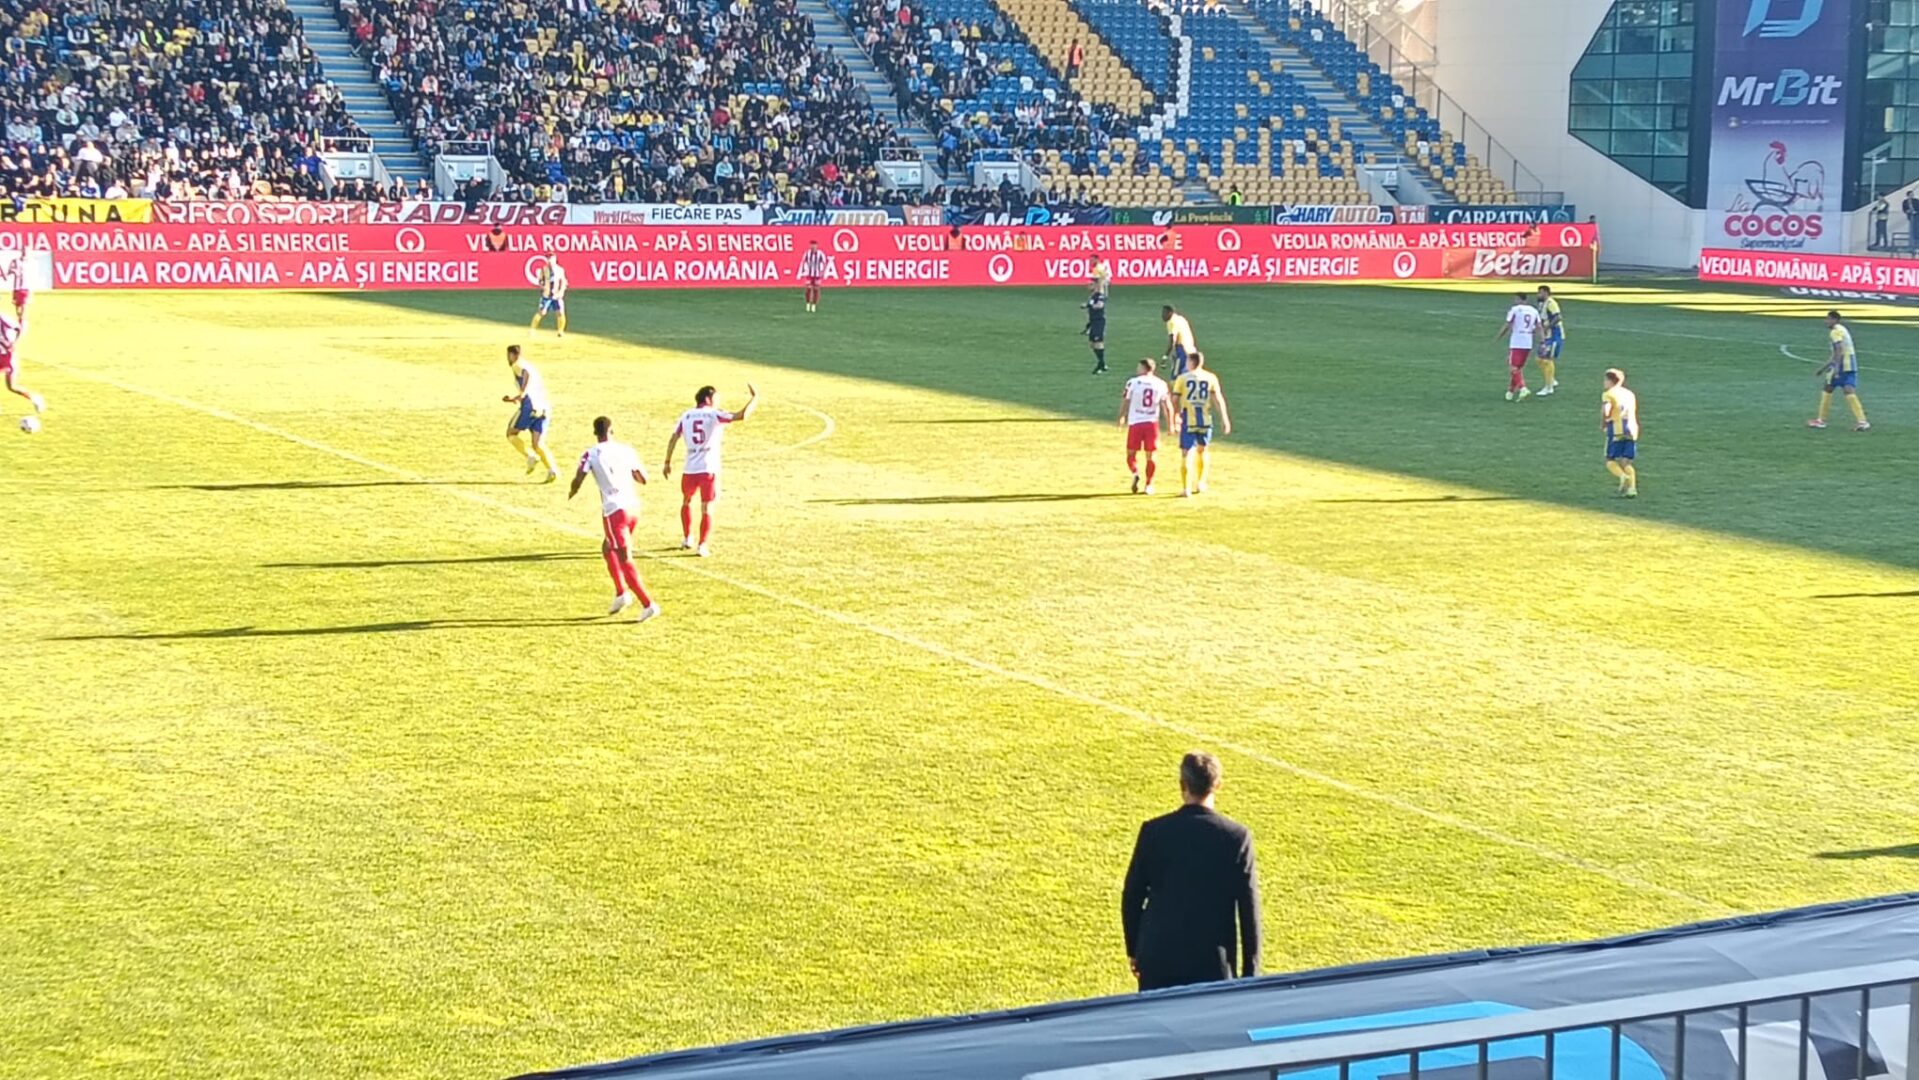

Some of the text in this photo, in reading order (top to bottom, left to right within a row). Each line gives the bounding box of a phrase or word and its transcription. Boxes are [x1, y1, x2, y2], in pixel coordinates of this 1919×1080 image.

[1717, 69, 1843, 106] MrBit
[257, 203, 356, 224] SPORT
[373, 202, 567, 225] RADBURG
[652, 208, 743, 220] FIECARE PAS
[1447, 209, 1550, 224] CARPATINA
[56, 228, 169, 252] ROMÂNIA
[187, 229, 231, 252] APĂ
[261, 233, 349, 252] ENERGIE
[466, 233, 539, 252] VELIA
[543, 229, 639, 252] ROMÂNIA
[654, 230, 692, 252] APĂ
[717, 233, 793, 252] ENERGIE
[894, 234, 945, 252] VEOLI
[1058, 231, 1093, 251] APĂ
[1114, 233, 1184, 251] ENERGE
[1271, 233, 1328, 250] VEOLIA
[1331, 229, 1405, 249] ROMÂNIA
[1419, 229, 1450, 248] APĂ
[56, 261, 149, 284] VEOLIA
[155, 257, 280, 283] ROMÂNIA
[300, 258, 349, 283] APĂ
[355, 261, 375, 288] ȘI
[382, 261, 479, 283] ENERGIE
[590, 260, 668, 282] VEOLIA
[674, 256, 778, 281] ROMÂNIA
[796, 255, 839, 280] AĂ
[843, 260, 860, 286] ȘI
[866, 259, 949, 280] ENERGIE
[1045, 259, 1112, 279] VEOLA
[1117, 254, 1209, 278] ROMÂNIA
[1224, 254, 1261, 277] APĂ
[1285, 257, 1359, 276] ENERGIE
[1472, 248, 1569, 276] Betano
[1701, 255, 1752, 276] VEOLIA
[1755, 258, 1829, 282] ROMÂNIA
[1840, 261, 1874, 284] APĂ
[1894, 266, 1919, 288] EN
[1523, 313, 1532, 329] 9
[1142, 388, 1154, 408] 8
[1186, 379, 1209, 400] 28
[692, 419, 706, 445] 5
